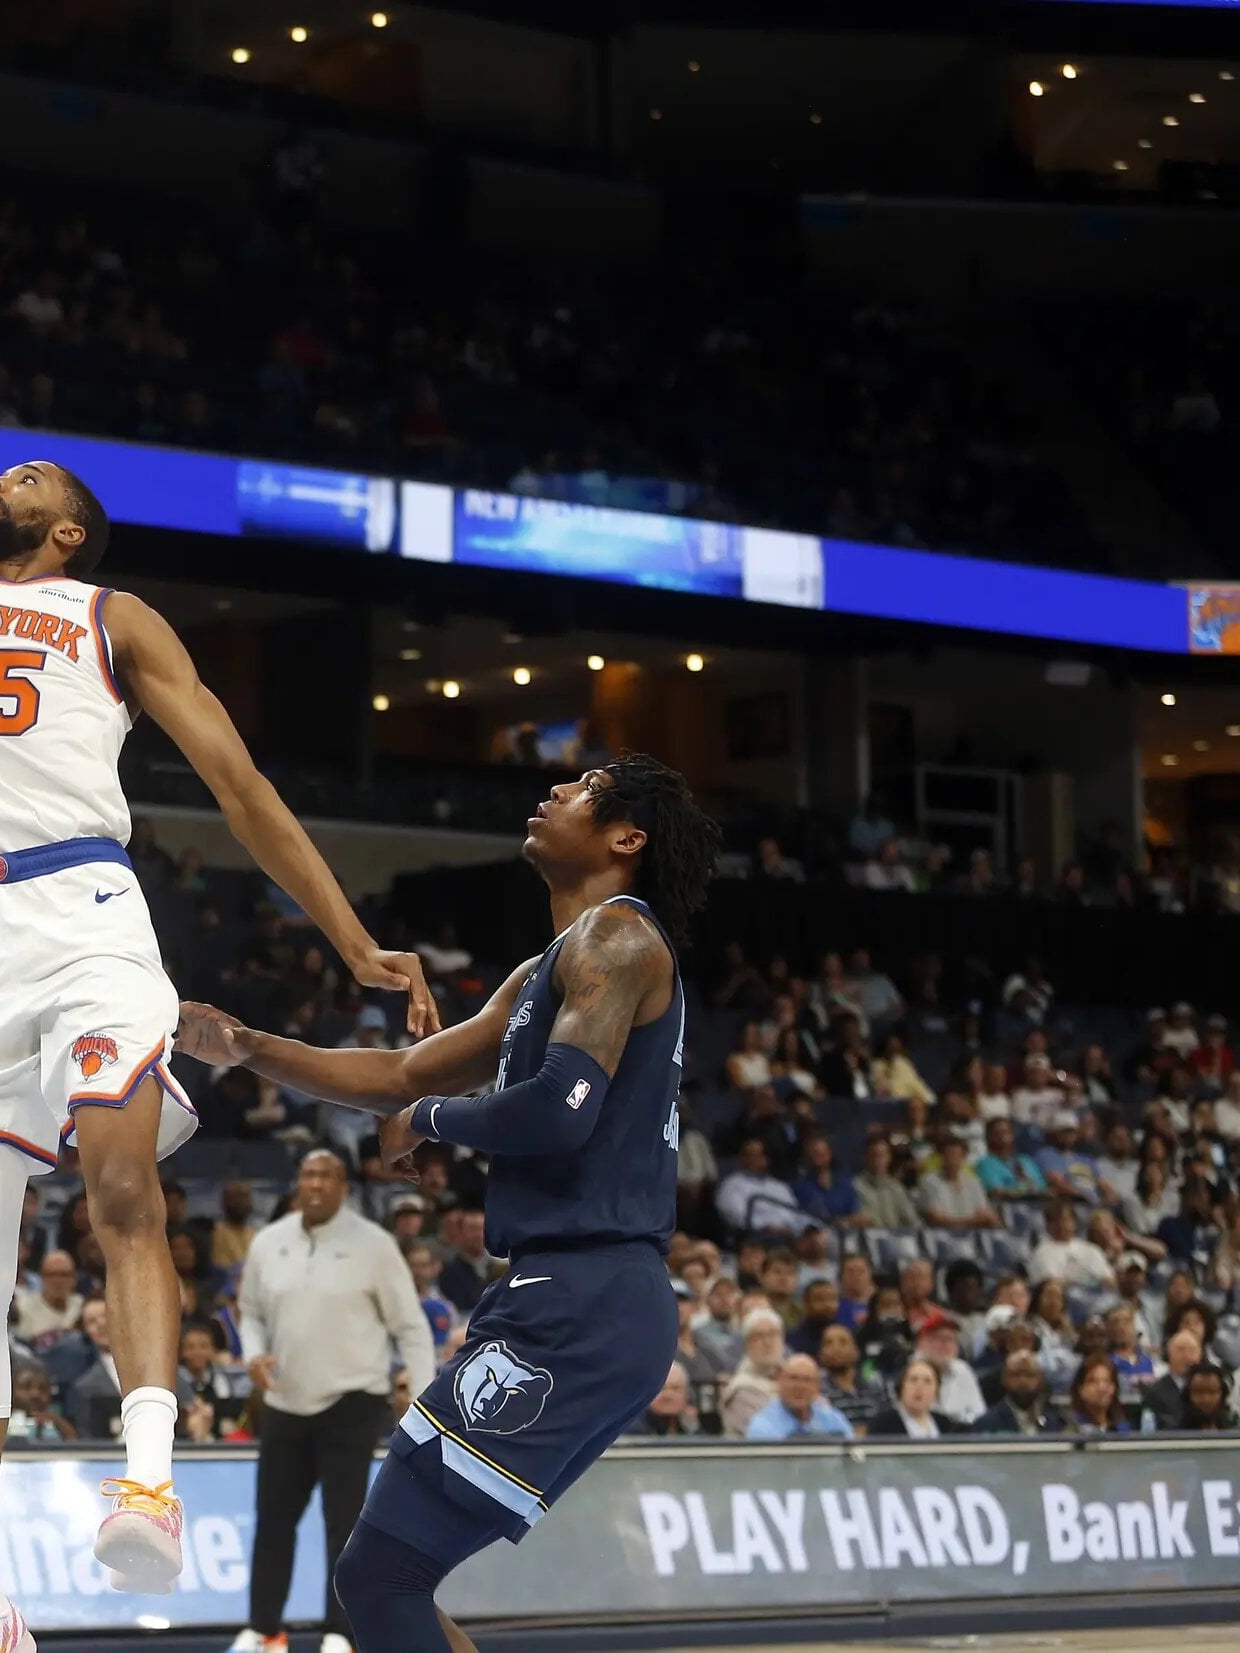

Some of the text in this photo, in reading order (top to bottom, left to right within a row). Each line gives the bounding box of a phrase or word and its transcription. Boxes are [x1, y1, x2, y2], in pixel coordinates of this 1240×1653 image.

[641, 1480, 1240, 1575] PLAY HARD, Bank E
